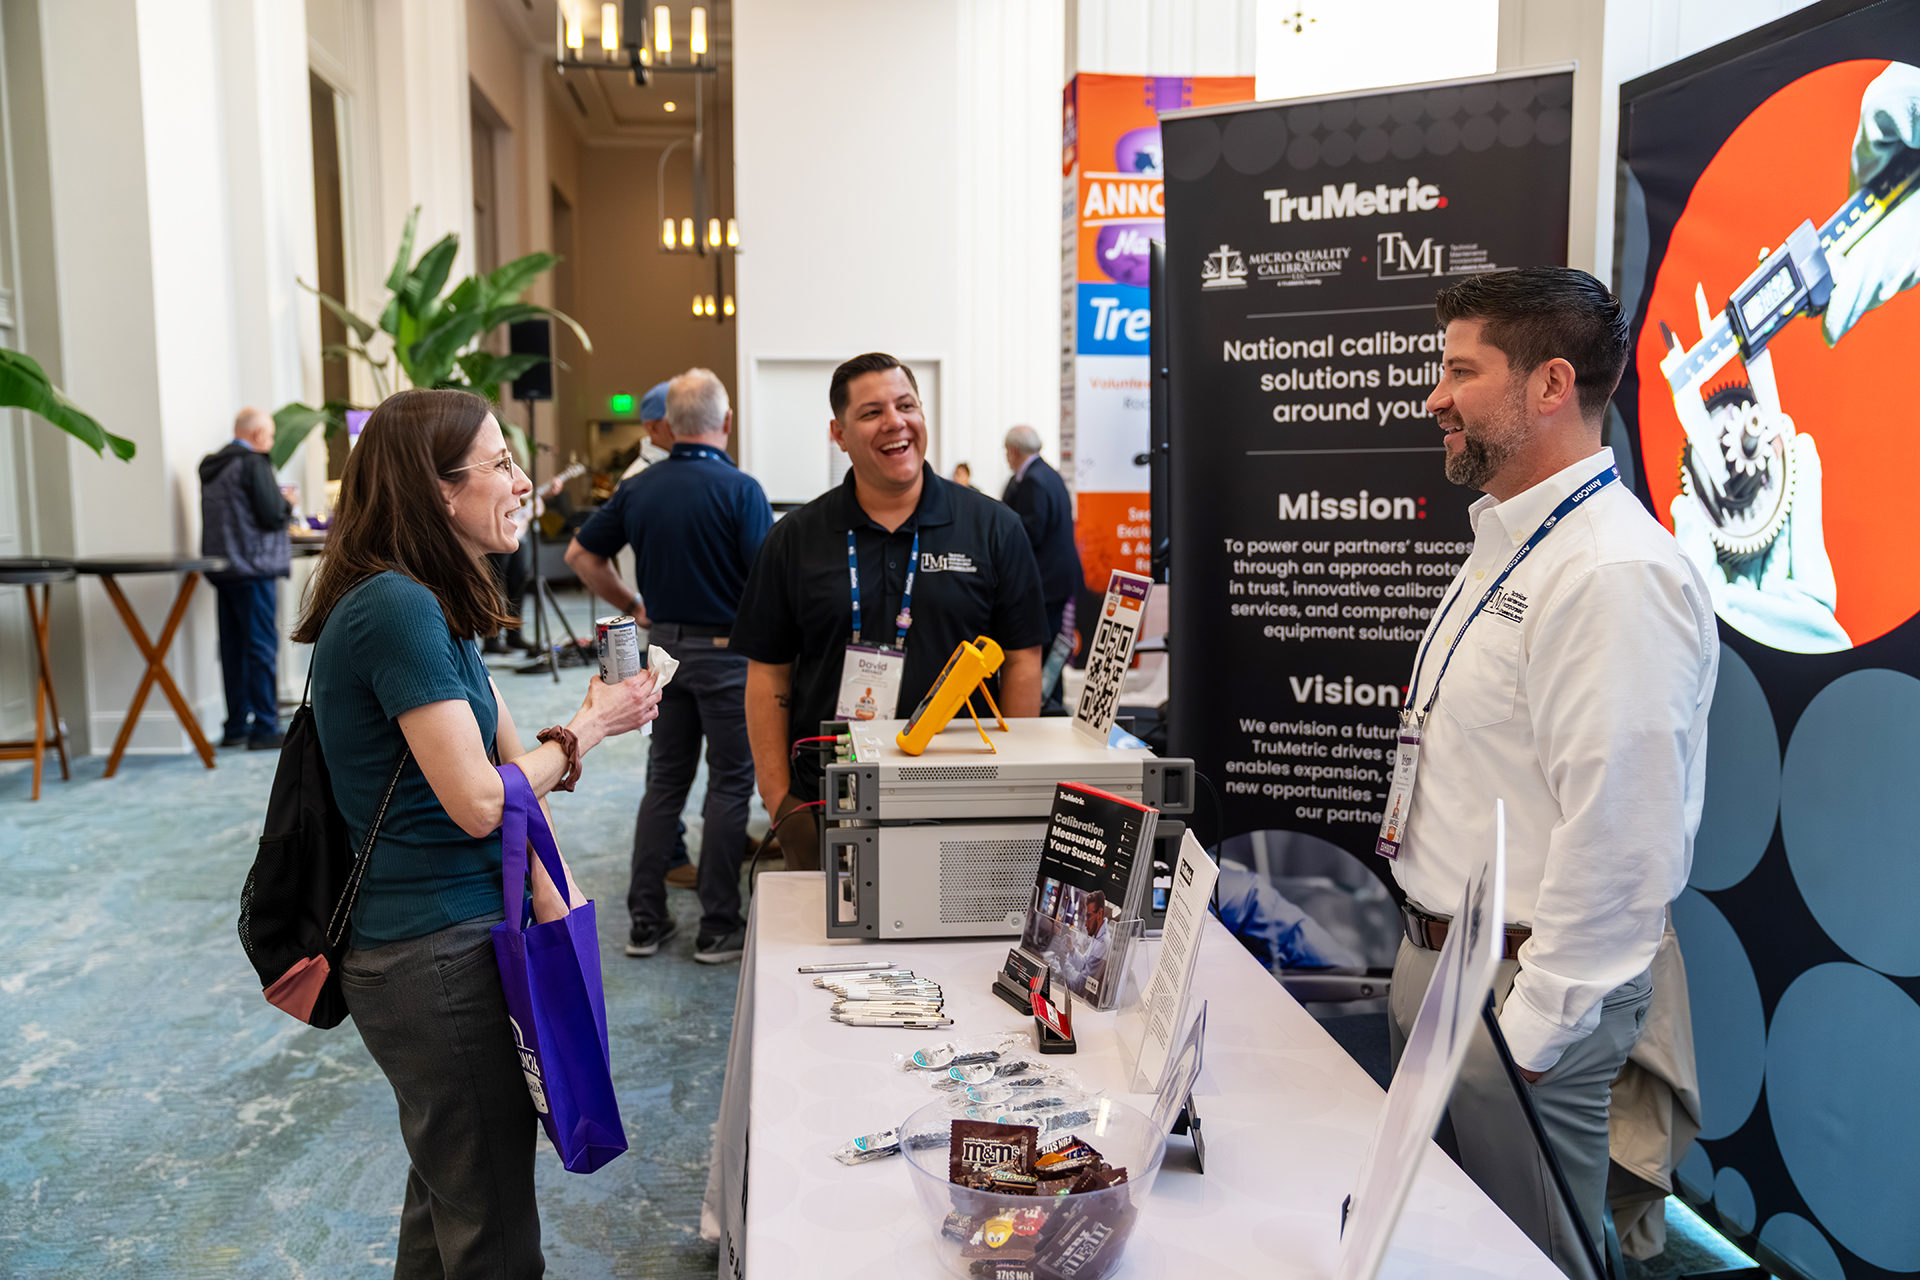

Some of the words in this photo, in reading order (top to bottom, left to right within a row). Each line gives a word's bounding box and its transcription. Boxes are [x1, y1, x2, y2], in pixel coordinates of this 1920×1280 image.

[1263, 176, 1448, 223] TruMetric.
[1249, 251, 1292, 265] MICRO
[1295, 247, 1352, 262] QUALITY
[1378, 231, 1446, 277] TMI
[1257, 260, 1342, 276] CALIBRATION
[1090, 297, 1150, 341] Tre
[1223, 334, 1334, 363] National
[1260, 366, 1380, 392] solutions
[1272, 397, 1369, 423] around
[1377, 399, 1434, 427] you
[1572, 479, 1602, 502] AnnCon
[1278, 489, 1427, 521] Mission:
[1224, 538, 1244, 553] To
[1246, 541, 1298, 558] power
[1302, 541, 1330, 554] our
[1504, 545, 1530, 572] AnnCon
[922, 553, 948, 570] TMI
[1233, 560, 1299, 579] through
[1301, 563, 1325, 576] an
[1328, 560, 1412, 580] approach
[1229, 581, 1244, 596] in
[1247, 581, 1289, 597] trust,
[1292, 580, 1380, 597] innovative
[1230, 602, 1302, 620] services,
[1305, 602, 1338, 619] and
[1263, 624, 1356, 643] equipment
[859, 658, 888, 671] David
[1239, 718, 1266, 733] We
[1269, 719, 1338, 738] envision
[1341, 724, 1353, 737] a
[1251, 738, 1328, 758] TruMetric
[1331, 741, 1383, 762] drives
[1225, 761, 1291, 777] enables
[1293, 766, 1383, 783] expansion,
[1225, 781, 1259, 796] new
[1261, 782, 1373, 802] opportunities
[1294, 807, 1323, 820] our
[1054, 813, 1105, 837] Calibration
[1051, 825, 1097, 849] Measured
[1095, 840, 1108, 855] By
[1049, 838, 1072, 855] Your
[1070, 845, 1106, 868] Success.
[1042, 1141, 1059, 1155] SIZE
[1058, 1135, 1072, 1149] FUN
